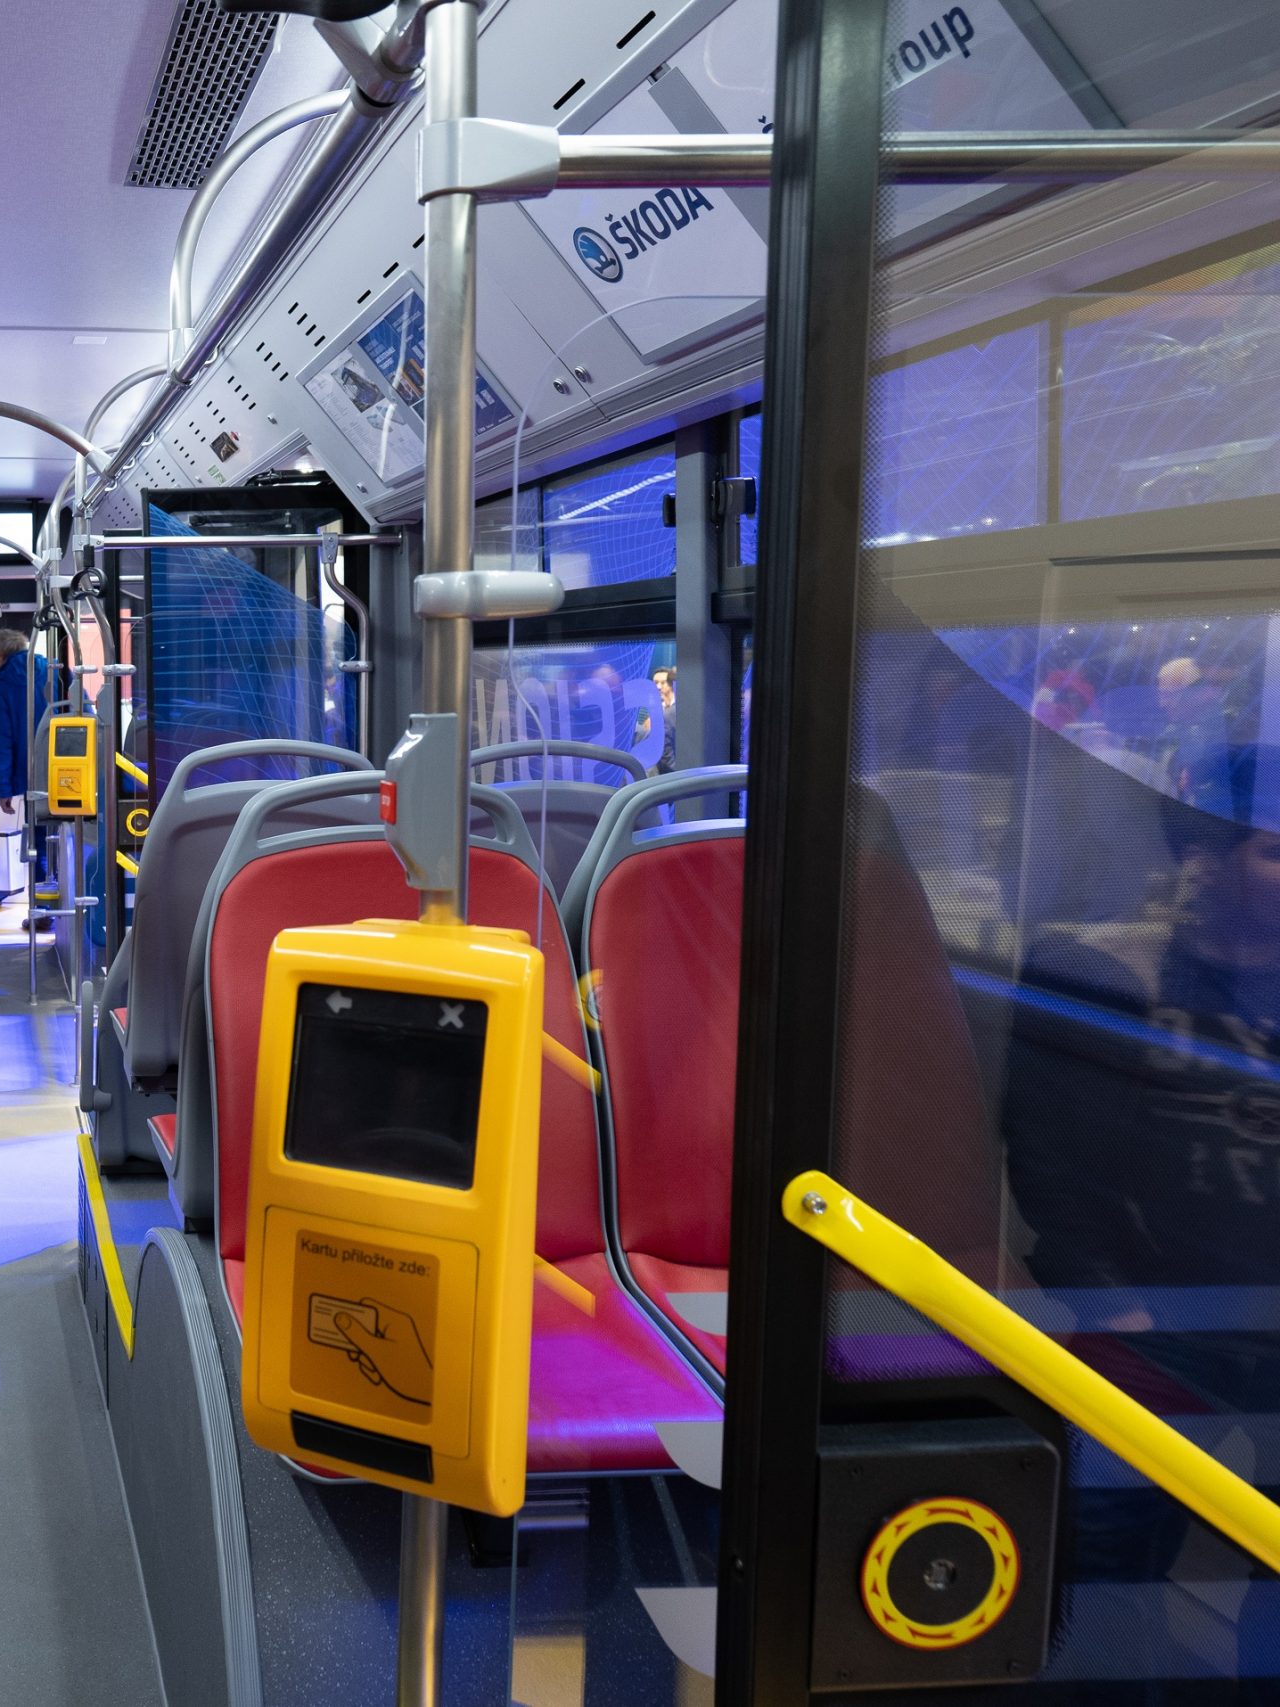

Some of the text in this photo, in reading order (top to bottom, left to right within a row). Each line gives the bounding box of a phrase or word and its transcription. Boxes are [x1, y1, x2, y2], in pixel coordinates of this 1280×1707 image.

[886, 6, 975, 84] roup
[605, 187, 714, 259] ŠKODA
[301, 1238, 338, 1258] Kartu
[342, 1248, 394, 1270] přiložte
